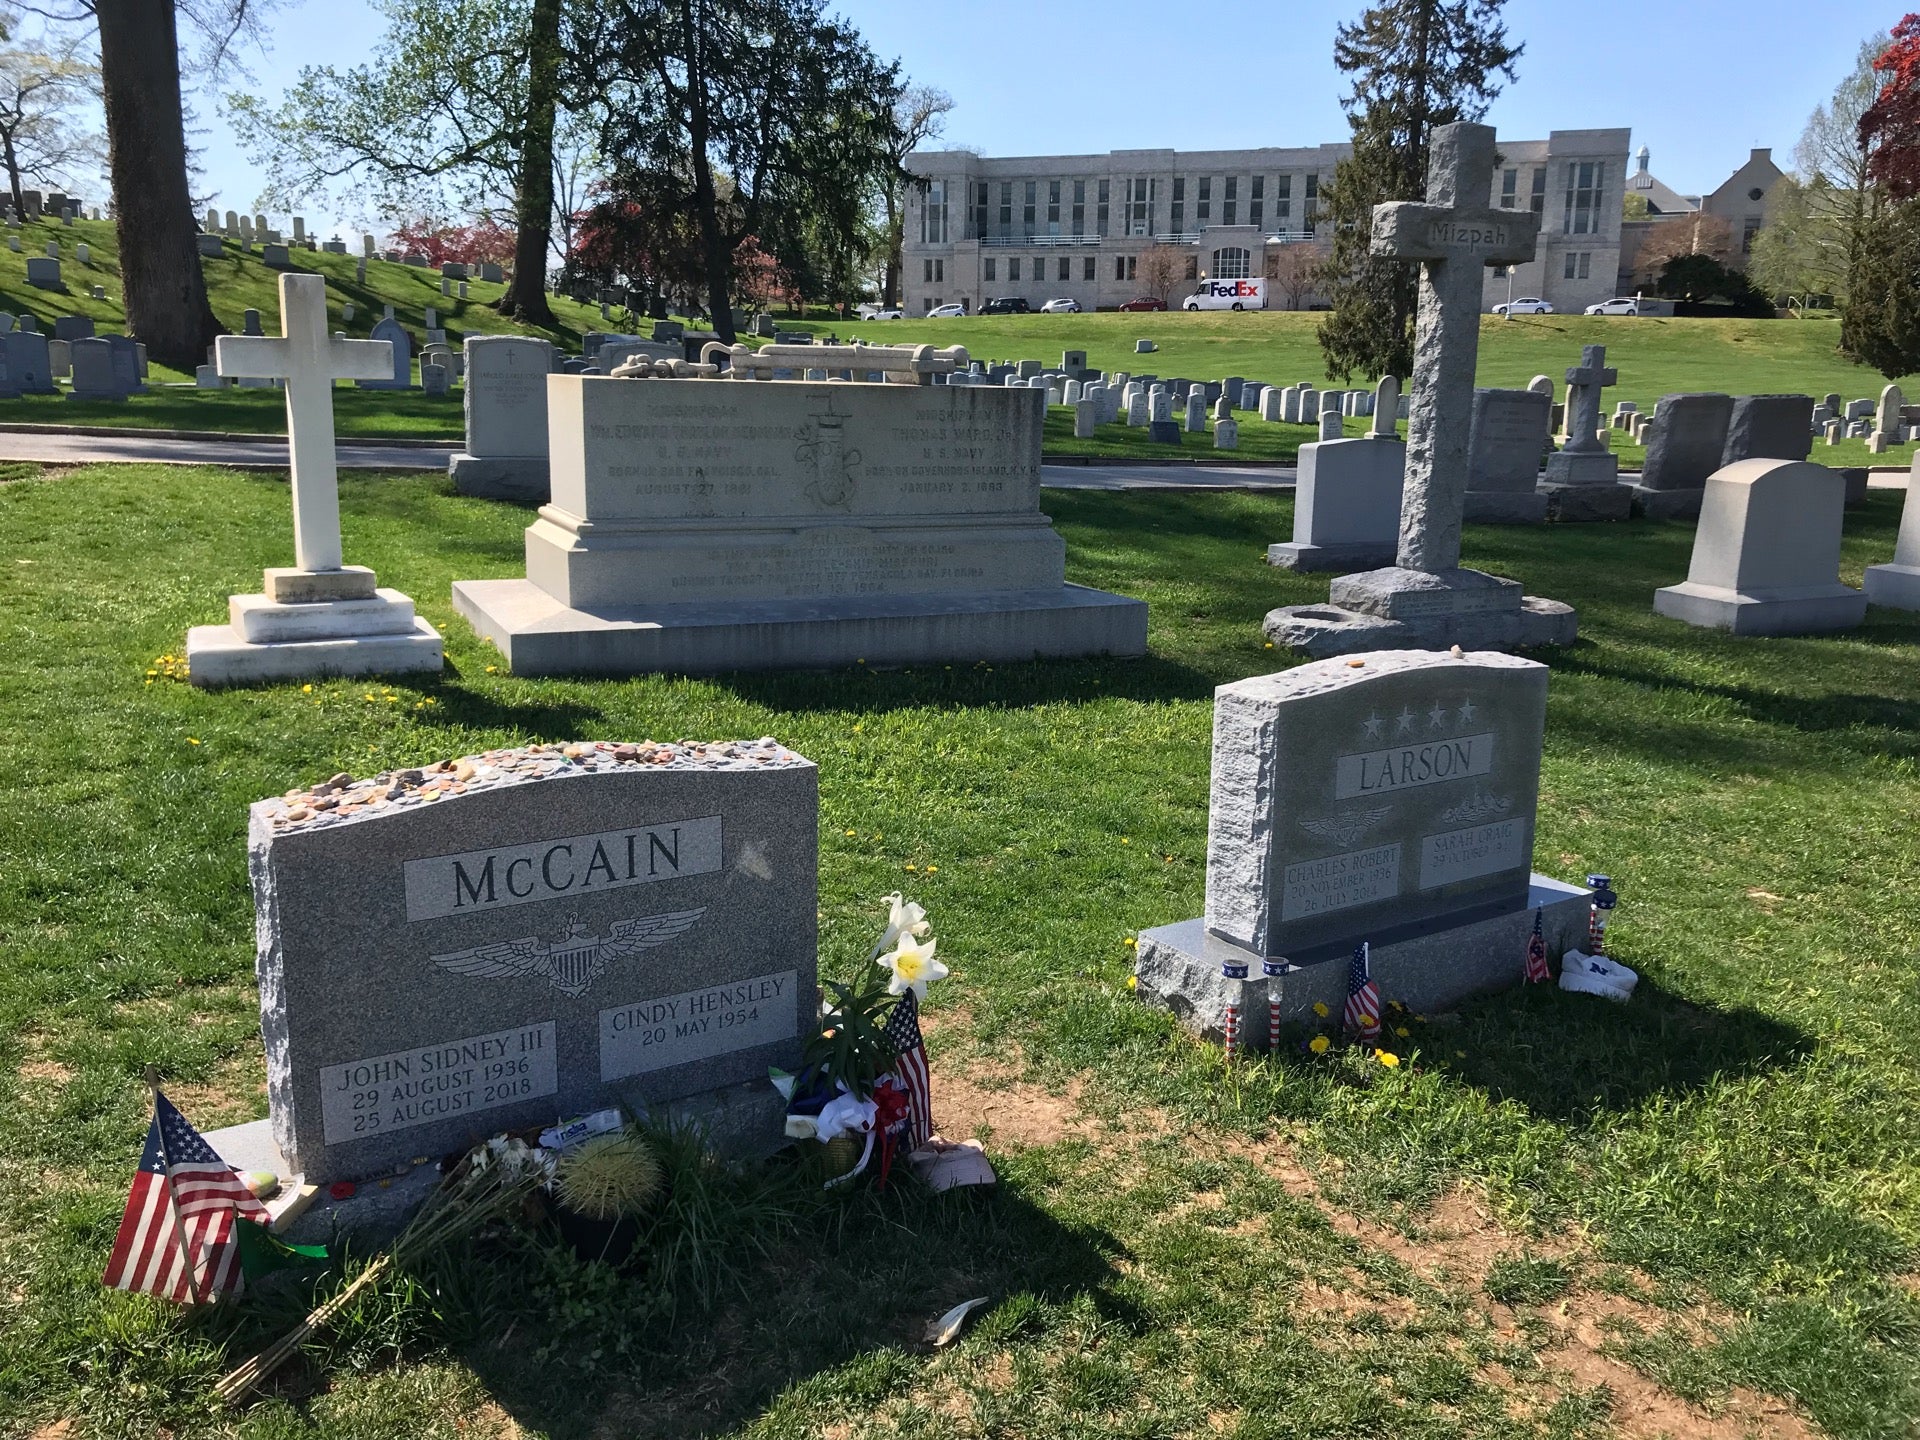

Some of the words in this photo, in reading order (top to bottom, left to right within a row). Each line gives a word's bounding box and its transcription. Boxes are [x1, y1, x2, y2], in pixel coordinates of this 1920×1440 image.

[1432, 223, 1505, 253] Mizpah
[1210, 280, 1259, 297] FedEx
[891, 428, 947, 441] THOMAS
[694, 446, 732, 459] NAVY
[954, 447, 986, 460] NAVY
[635, 484, 690, 497] AUGUST
[900, 482, 954, 494] JANUARY
[1359, 740, 1473, 791] LARSON
[1434, 831, 1474, 853] SARAH
[1287, 858, 1348, 885] CHARLES
[1353, 847, 1398, 871] ROBERT
[1292, 885, 1307, 900] 20
[1311, 873, 1366, 896] NOVEMBER
[1370, 867, 1392, 883] 1936
[1304, 899, 1319, 912] 26
[1322, 891, 1348, 909] JULY
[1589, 962, 1609, 976] N
[612, 1001, 681, 1032] CINDY
[689, 977, 786, 1015] HENSLEY
[642, 1027, 667, 1046] 20
[675, 1017, 711, 1039] MAY
[718, 1008, 760, 1029] 1954
[337, 1057, 411, 1091] JOHN
[421, 1036, 510, 1074] SIDNEY
[519, 1029, 543, 1052] III
[353, 1089, 380, 1110] 29
[391, 1069, 475, 1102] AUGUST
[484, 1056, 530, 1082] 1936
[353, 1112, 381, 1132] 25
[391, 1091, 475, 1125] AUGUST
[484, 1078, 531, 1102] 2018
